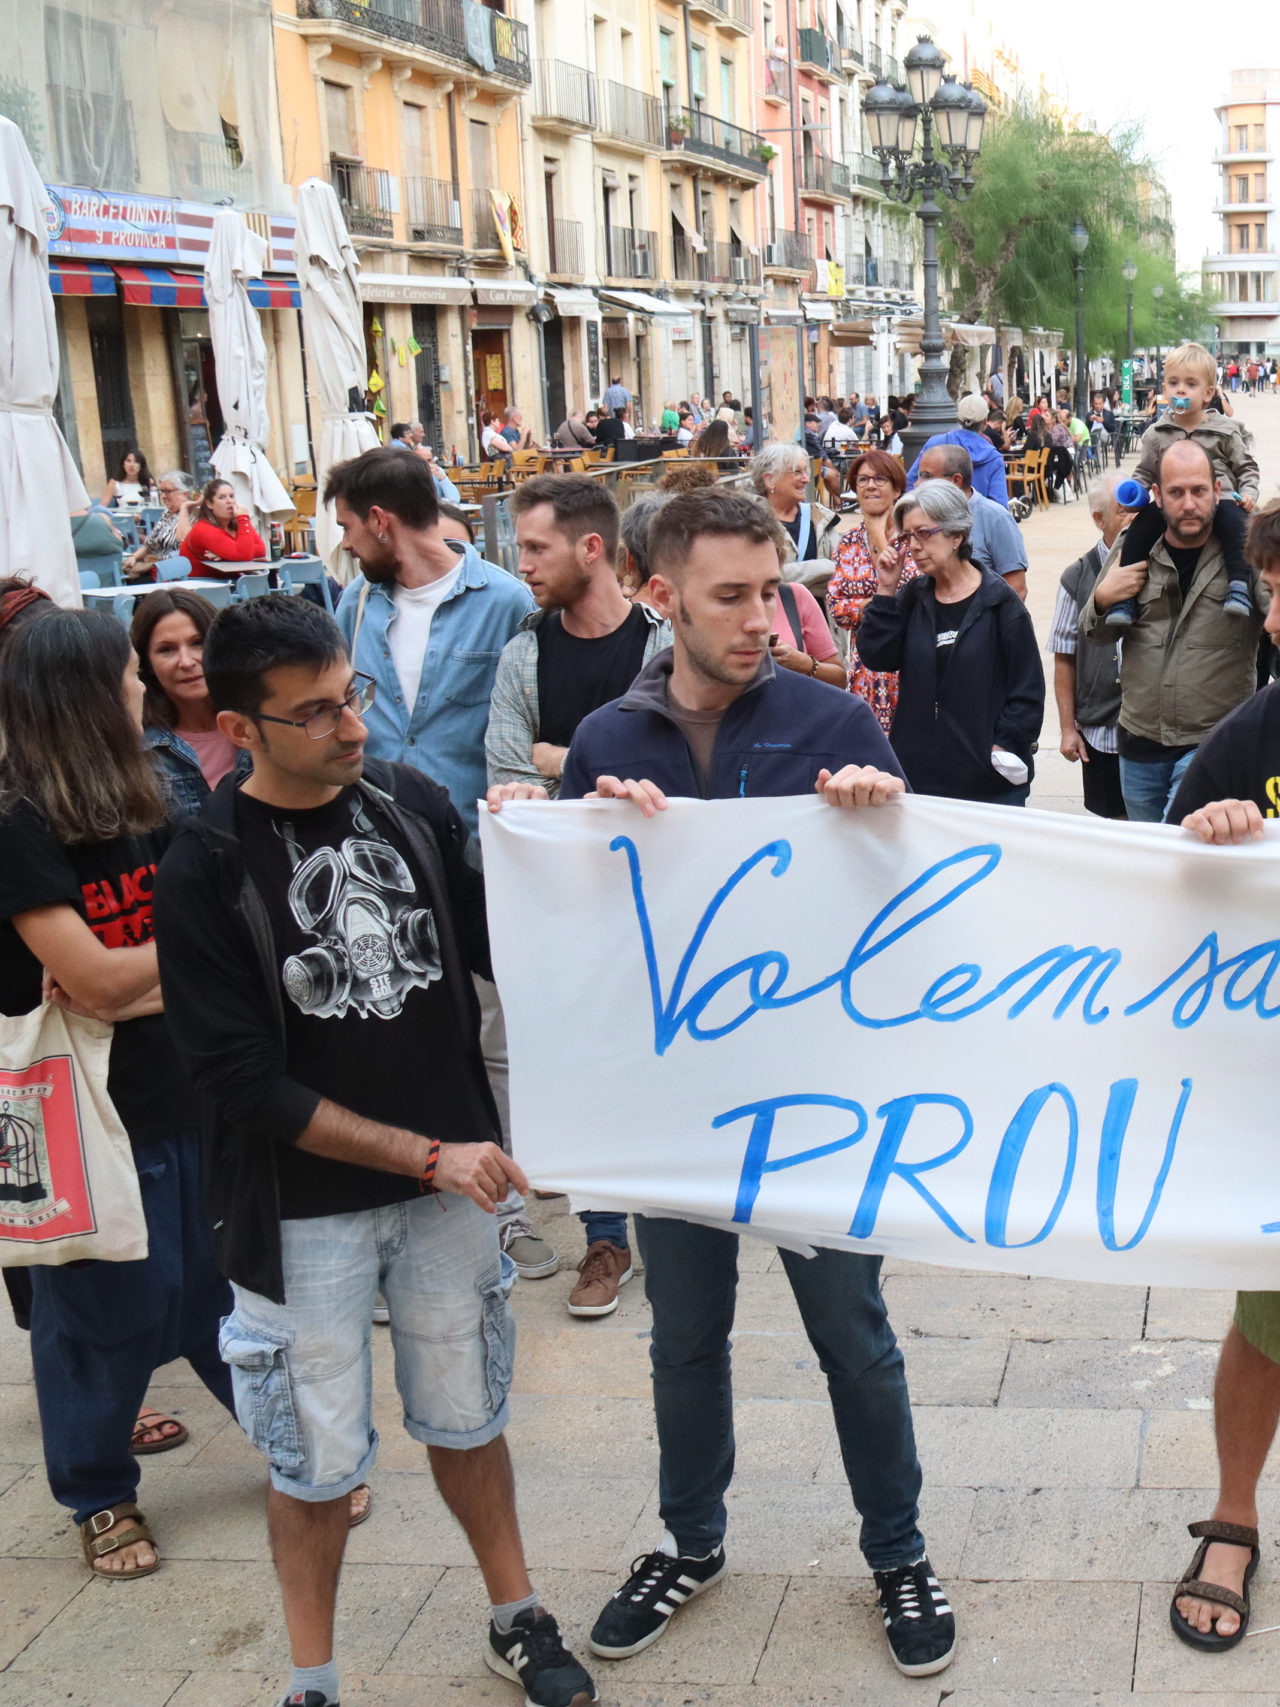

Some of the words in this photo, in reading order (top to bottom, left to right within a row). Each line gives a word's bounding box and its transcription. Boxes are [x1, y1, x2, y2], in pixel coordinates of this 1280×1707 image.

[71, 192, 174, 227] BARCELONISTA
[112, 229, 166, 249] PROVINCIA
[360, 284, 395, 300] afeteria
[82, 863, 157, 919] BLAC
[610, 836, 1123, 1056] Volem
[711, 1077, 1193, 1252] PROU
